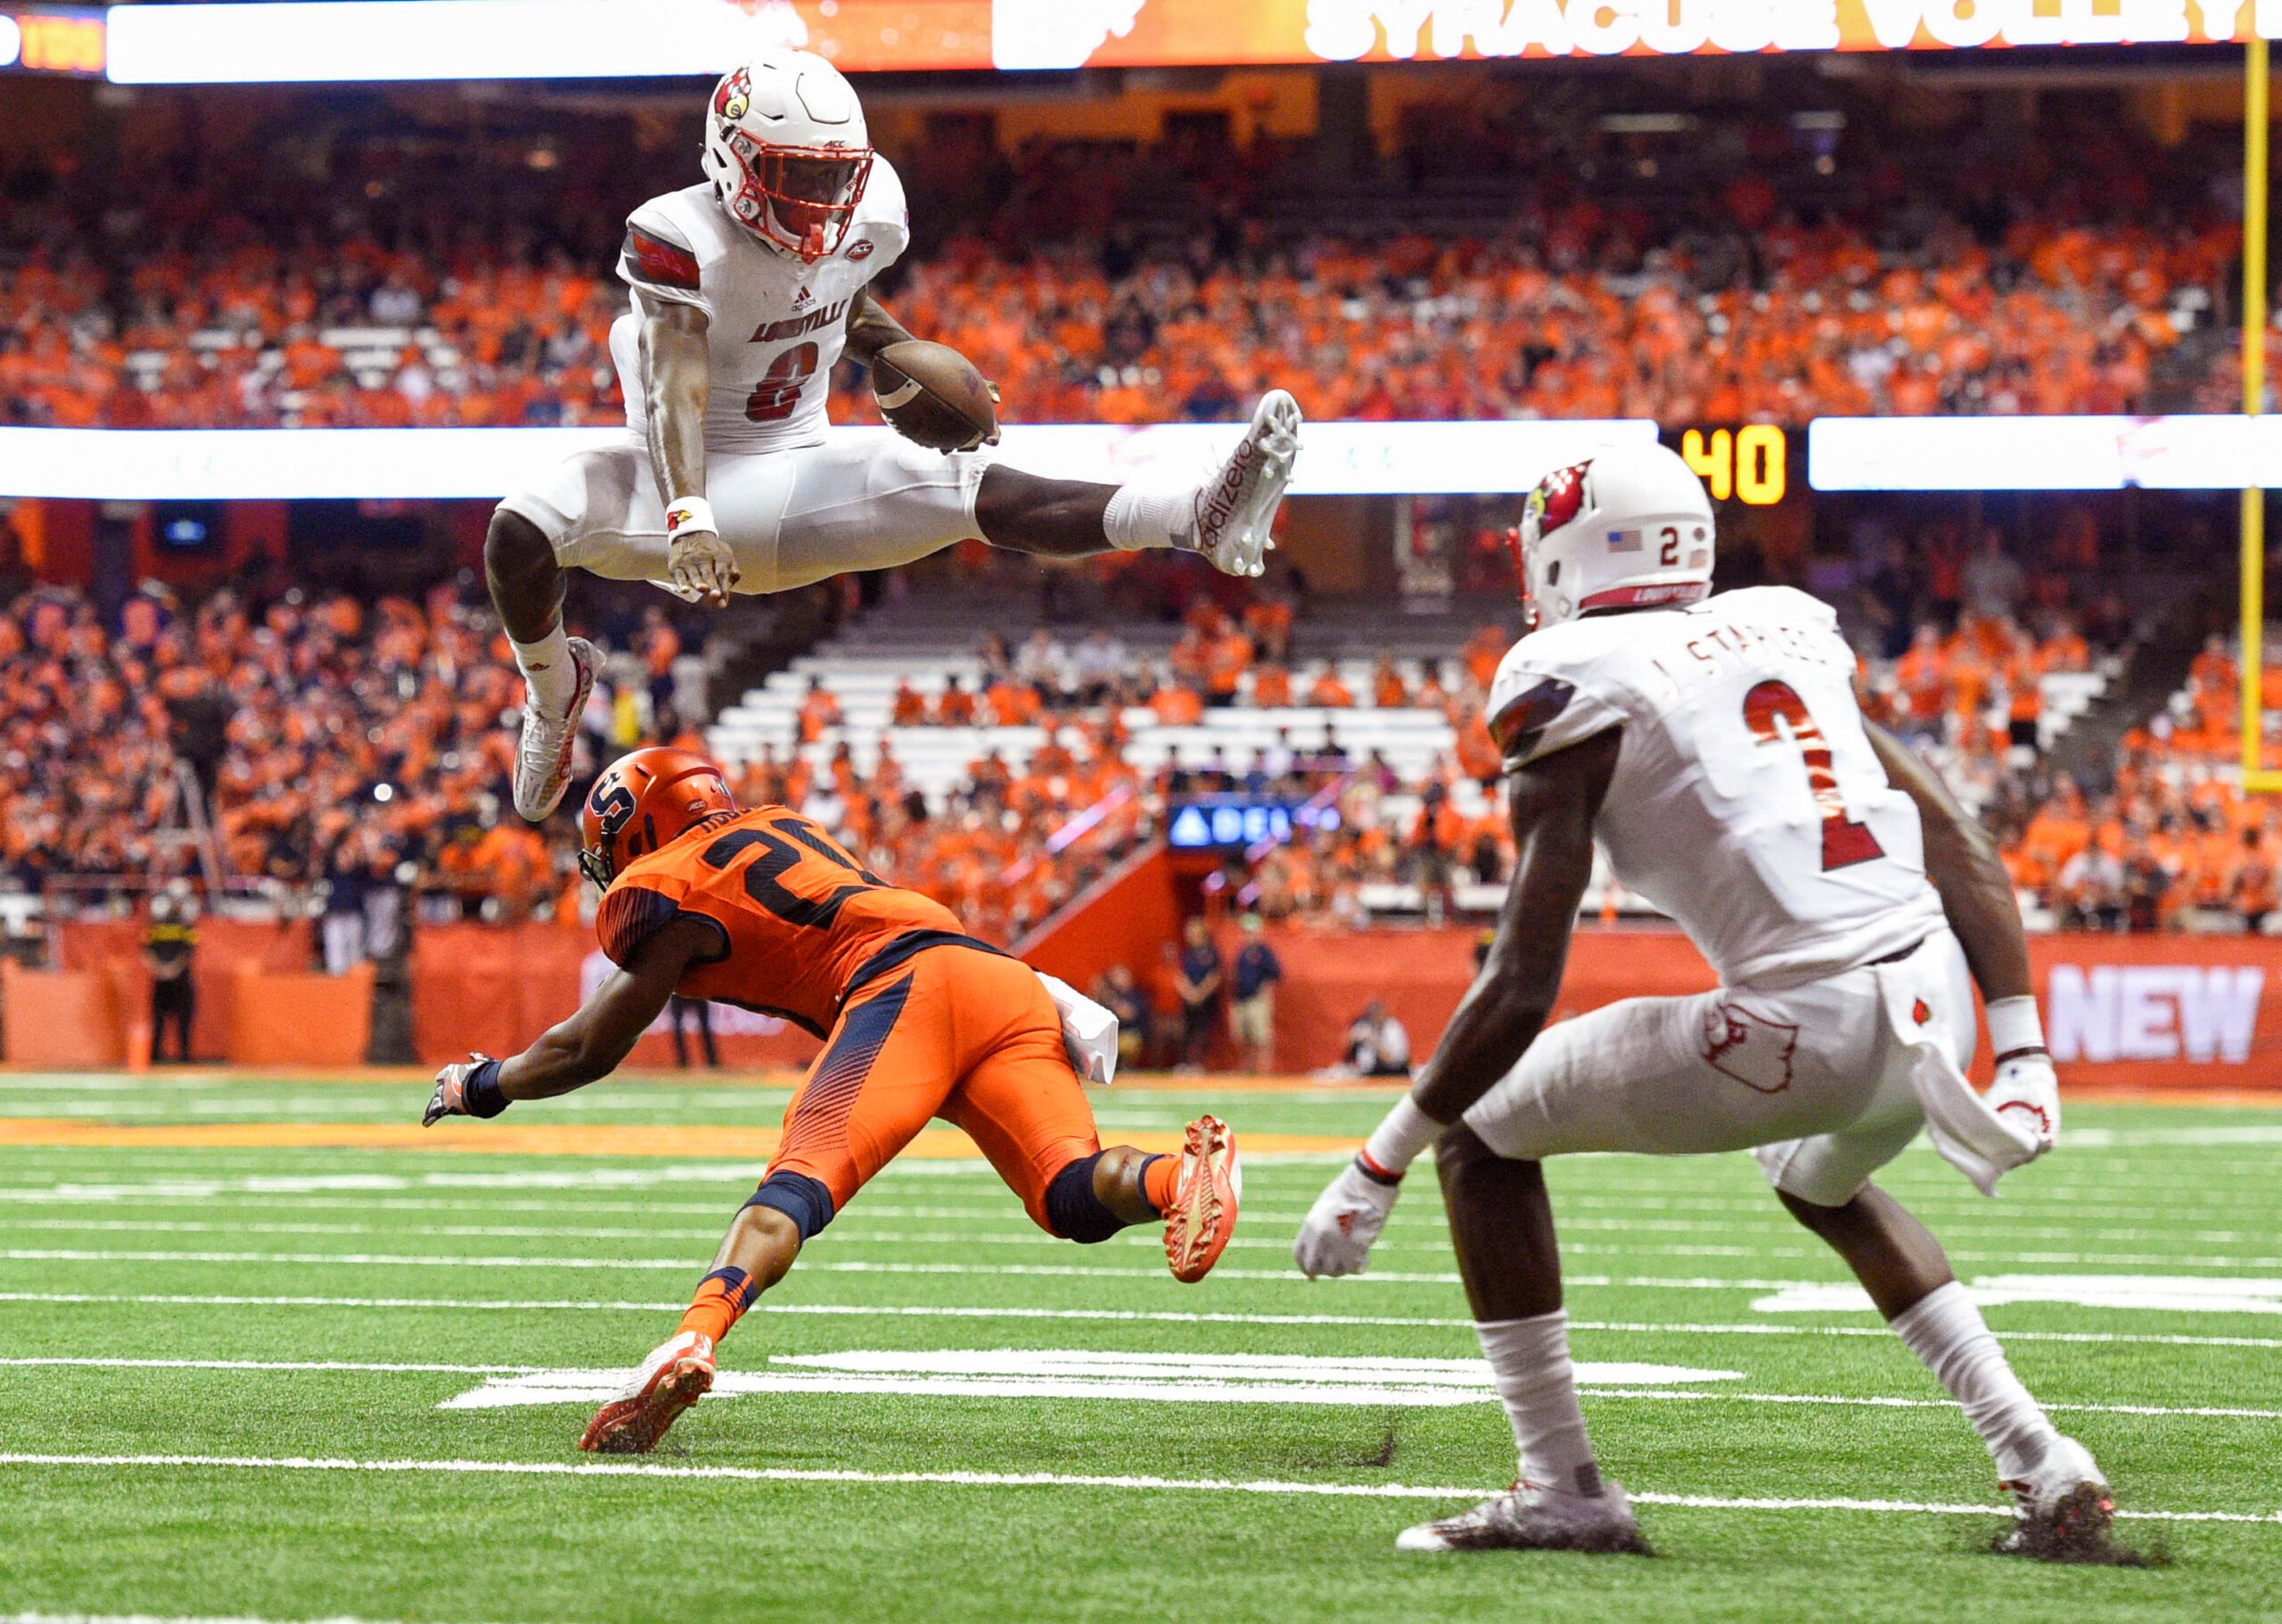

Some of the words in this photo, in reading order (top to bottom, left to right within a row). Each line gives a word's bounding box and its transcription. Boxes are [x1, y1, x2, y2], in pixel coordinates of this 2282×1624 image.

[823, 140, 846, 148] ACC
[847, 242, 873, 256] ACC
[1203, 439, 1252, 548] adizero
[1683, 424, 1785, 504] 40
[1660, 527, 1679, 566] 2
[2049, 964, 2265, 1064] NEW
